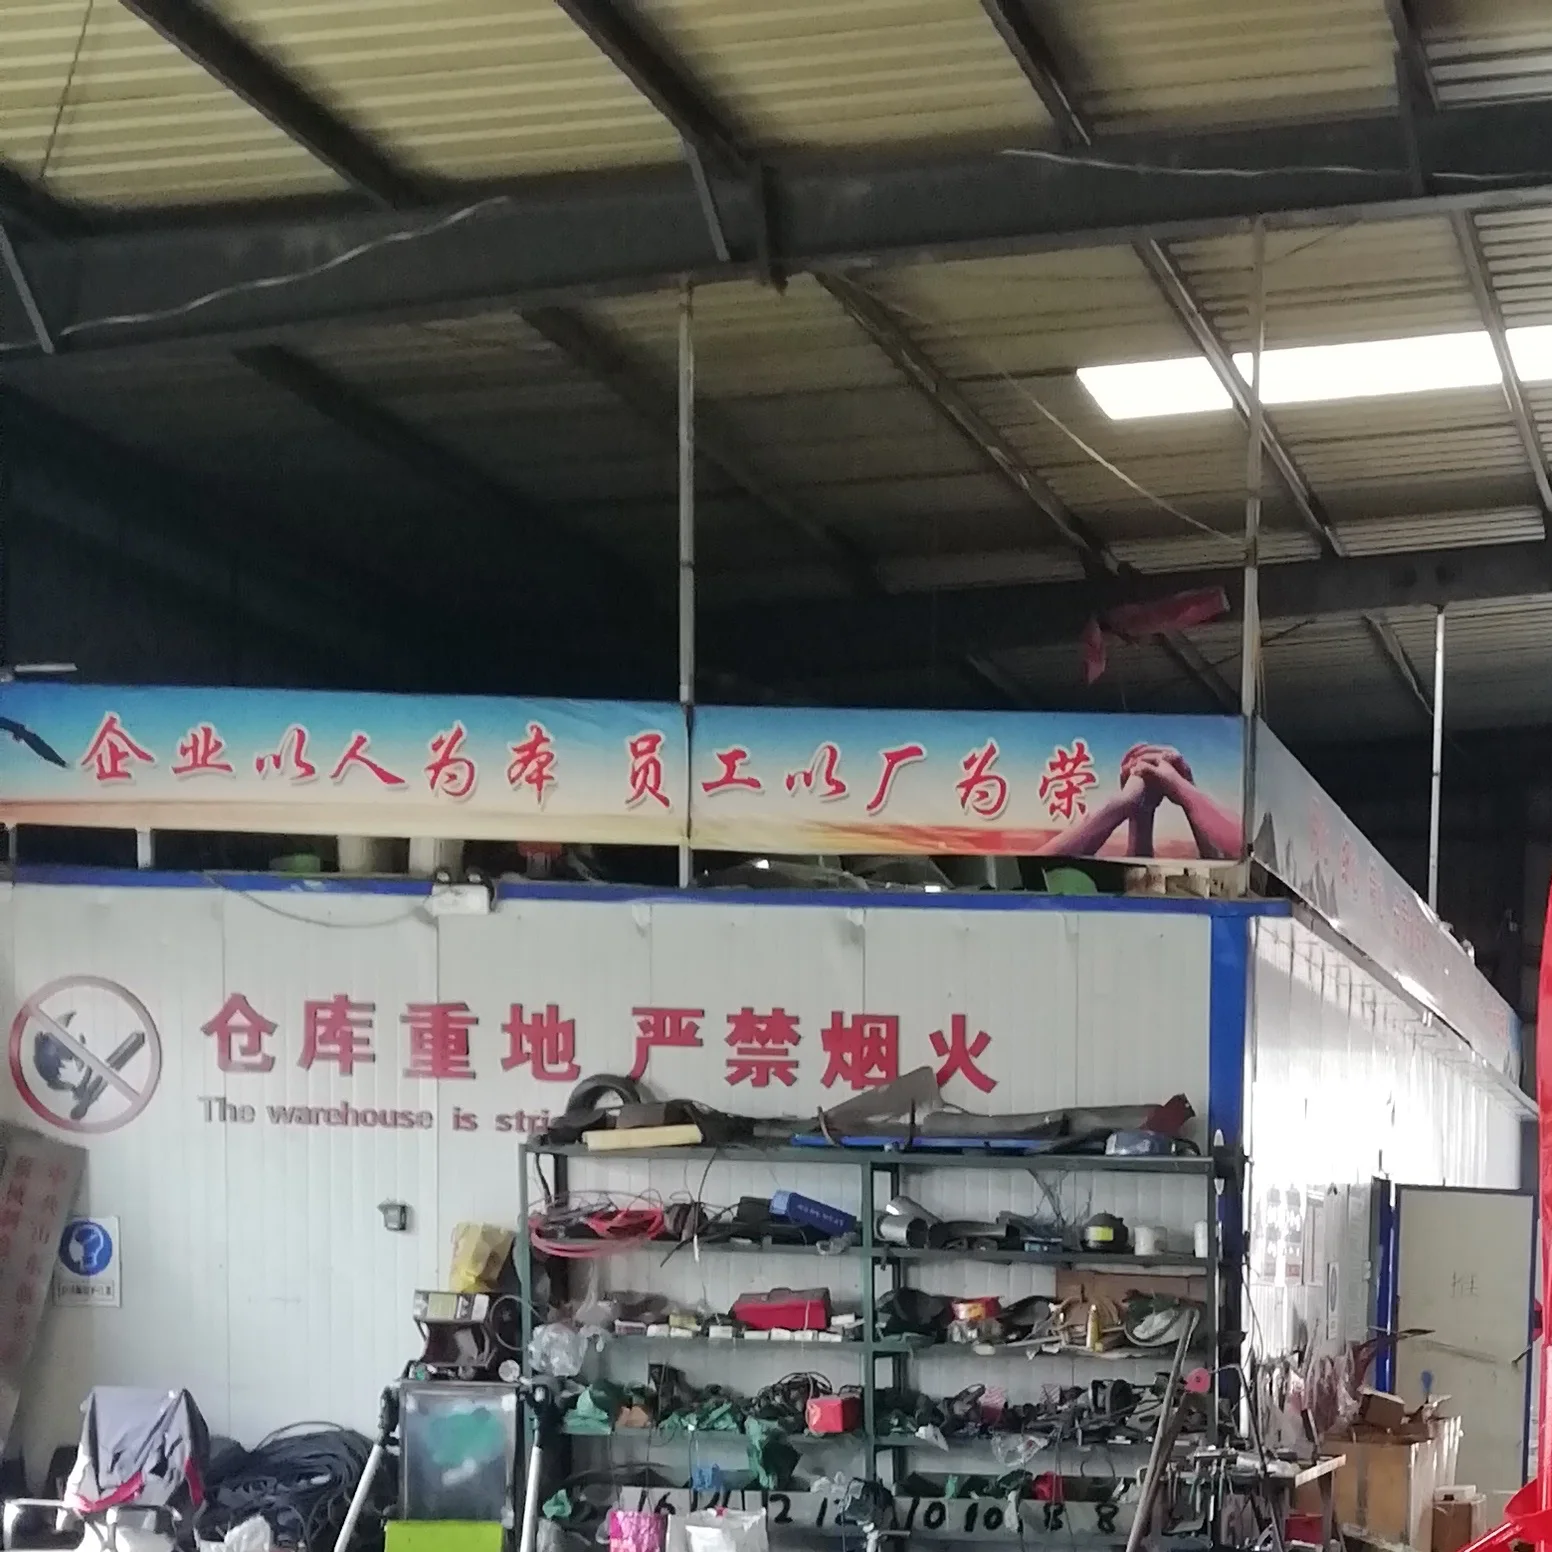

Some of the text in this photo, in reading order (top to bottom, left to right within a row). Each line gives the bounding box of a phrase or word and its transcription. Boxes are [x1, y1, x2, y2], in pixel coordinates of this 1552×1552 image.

[80, 714, 1099, 818] 企业以人为本 员工以厂为荣
[200, 992, 998, 1093] 仓库重地 严禁烟火
[199, 1096, 256, 1123] The
[266, 1101, 433, 1129] warehouse
[453, 1106, 477, 1132] is
[964, 1503, 1003, 1533] 10
